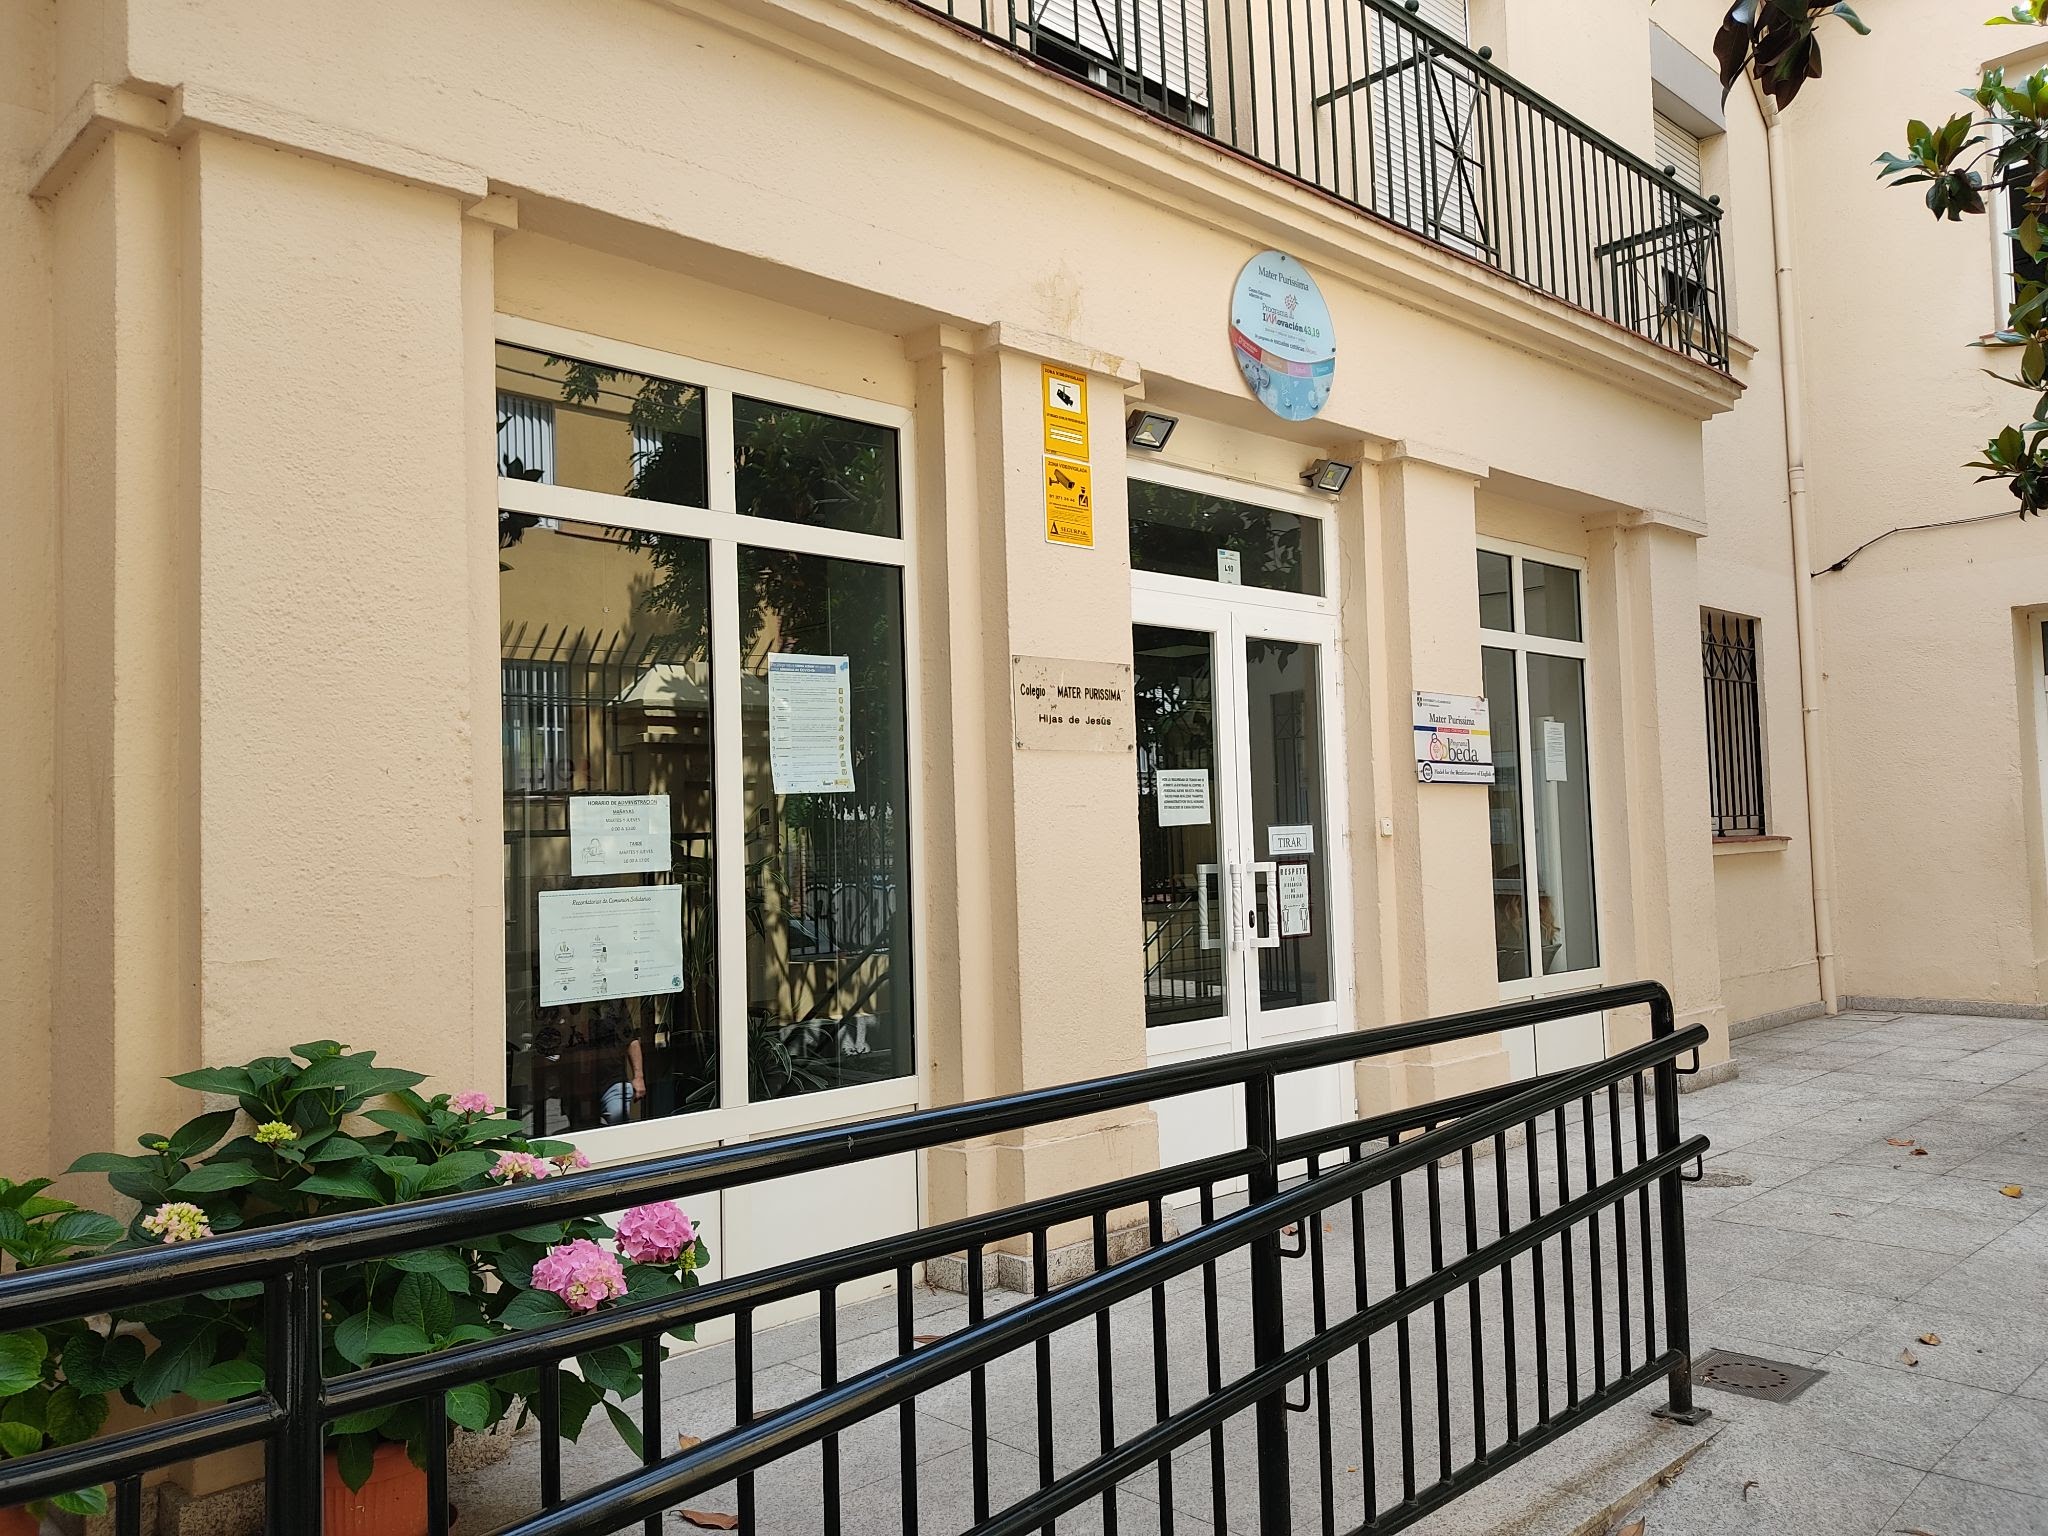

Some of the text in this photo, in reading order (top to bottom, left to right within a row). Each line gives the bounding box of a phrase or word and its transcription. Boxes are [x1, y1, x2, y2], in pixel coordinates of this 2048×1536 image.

[1258, 265, 1309, 291] Mater Purissima
[1020, 683, 1046, 699] Colegio
[1039, 714, 1112, 726] Hijas de Jesús
[1429, 713, 1476, 726] Mater Purissima
[1447, 737, 1479, 762] beda
[1278, 837, 1302, 848] TIRAR
[1280, 867, 1306, 876] RESPETE
